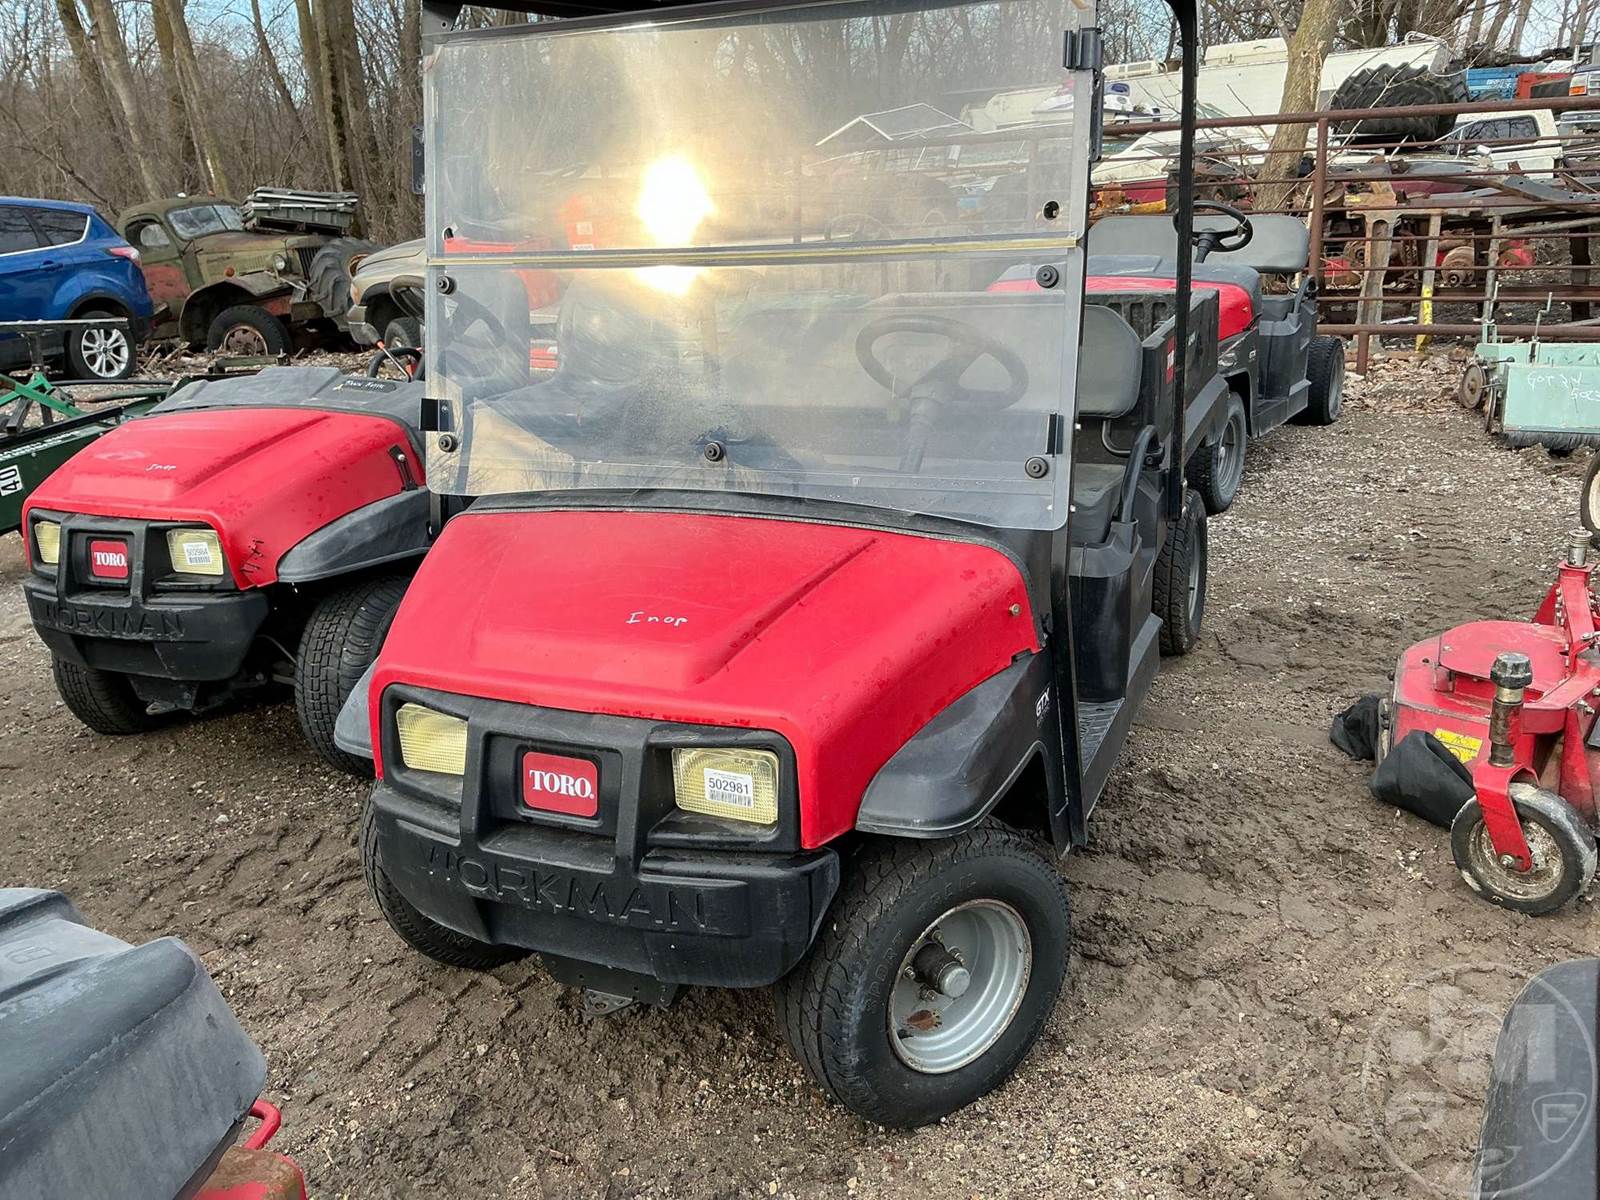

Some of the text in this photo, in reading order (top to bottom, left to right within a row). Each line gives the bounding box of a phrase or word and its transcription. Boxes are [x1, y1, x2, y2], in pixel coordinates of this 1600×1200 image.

[625, 611, 688, 627] Inop
[529, 769, 592, 798] TORO
[708, 777, 749, 795] 502981
